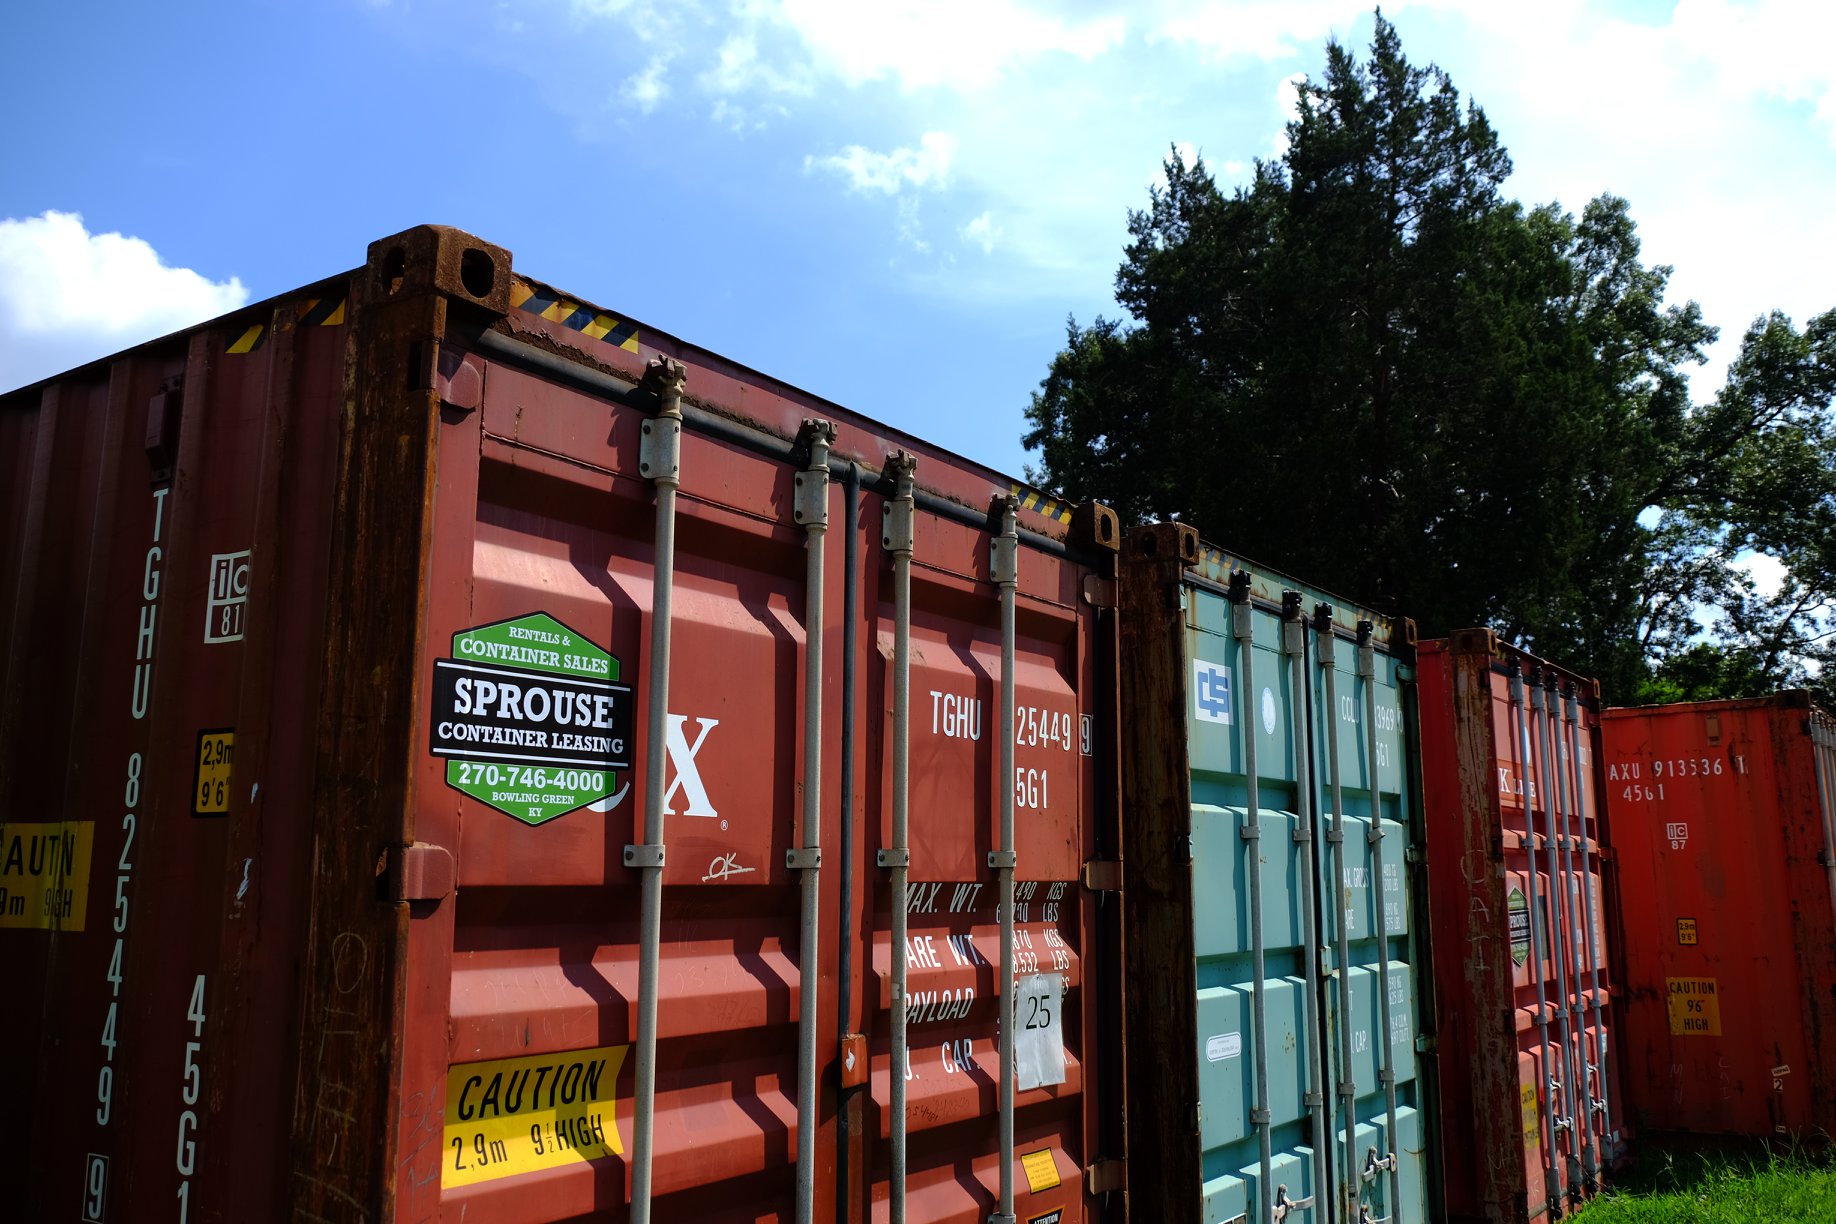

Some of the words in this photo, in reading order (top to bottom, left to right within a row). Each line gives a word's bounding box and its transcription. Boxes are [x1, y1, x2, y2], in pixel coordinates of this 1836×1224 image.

[132, 488, 168, 719] TGHU
[220, 604, 241, 635] 81
[509, 626, 560, 645] RENTALS
[562, 636, 571, 647] &
[460, 638, 560, 667] CONTAINER
[563, 654, 608, 674] SALES
[454, 677, 613, 729] SPROUSE
[1375, 705, 1394, 731] 3969
[930, 691, 981, 741] TGHU
[1016, 706, 1071, 751] 25449
[1081, 717, 1091, 753] 9
[438, 722, 548, 749] CONTAINER
[551, 732, 624, 754] LEASING
[1376, 742, 1389, 767] 5G1
[459, 763, 604, 791] 270-746-4000
[1016, 767, 1048, 808] 5G1
[492, 791, 539, 804] BOWLING
[542, 793, 574, 805] GREEN
[529, 807, 543, 817] KY
[1671, 840, 1686, 850] 87
[949, 883, 983, 913] WT.
[1046, 882, 1067, 901] KGS
[1042, 902, 1059, 923] LBS
[96, 752, 142, 1126] 825449
[905, 935, 942, 968] ARE
[946, 934, 986, 966] WT.
[1043, 928, 1064, 948] KGS
[1051, 949, 1070, 971] LBS
[1669, 982, 1715, 995] CAUTION
[1025, 994, 1051, 1030] 25
[1683, 1018, 1709, 1031] HIGH
[458, 1059, 606, 1121] CAUTION
[451, 1133, 508, 1172] 2,9m
[88, 1158, 105, 1219] 9
